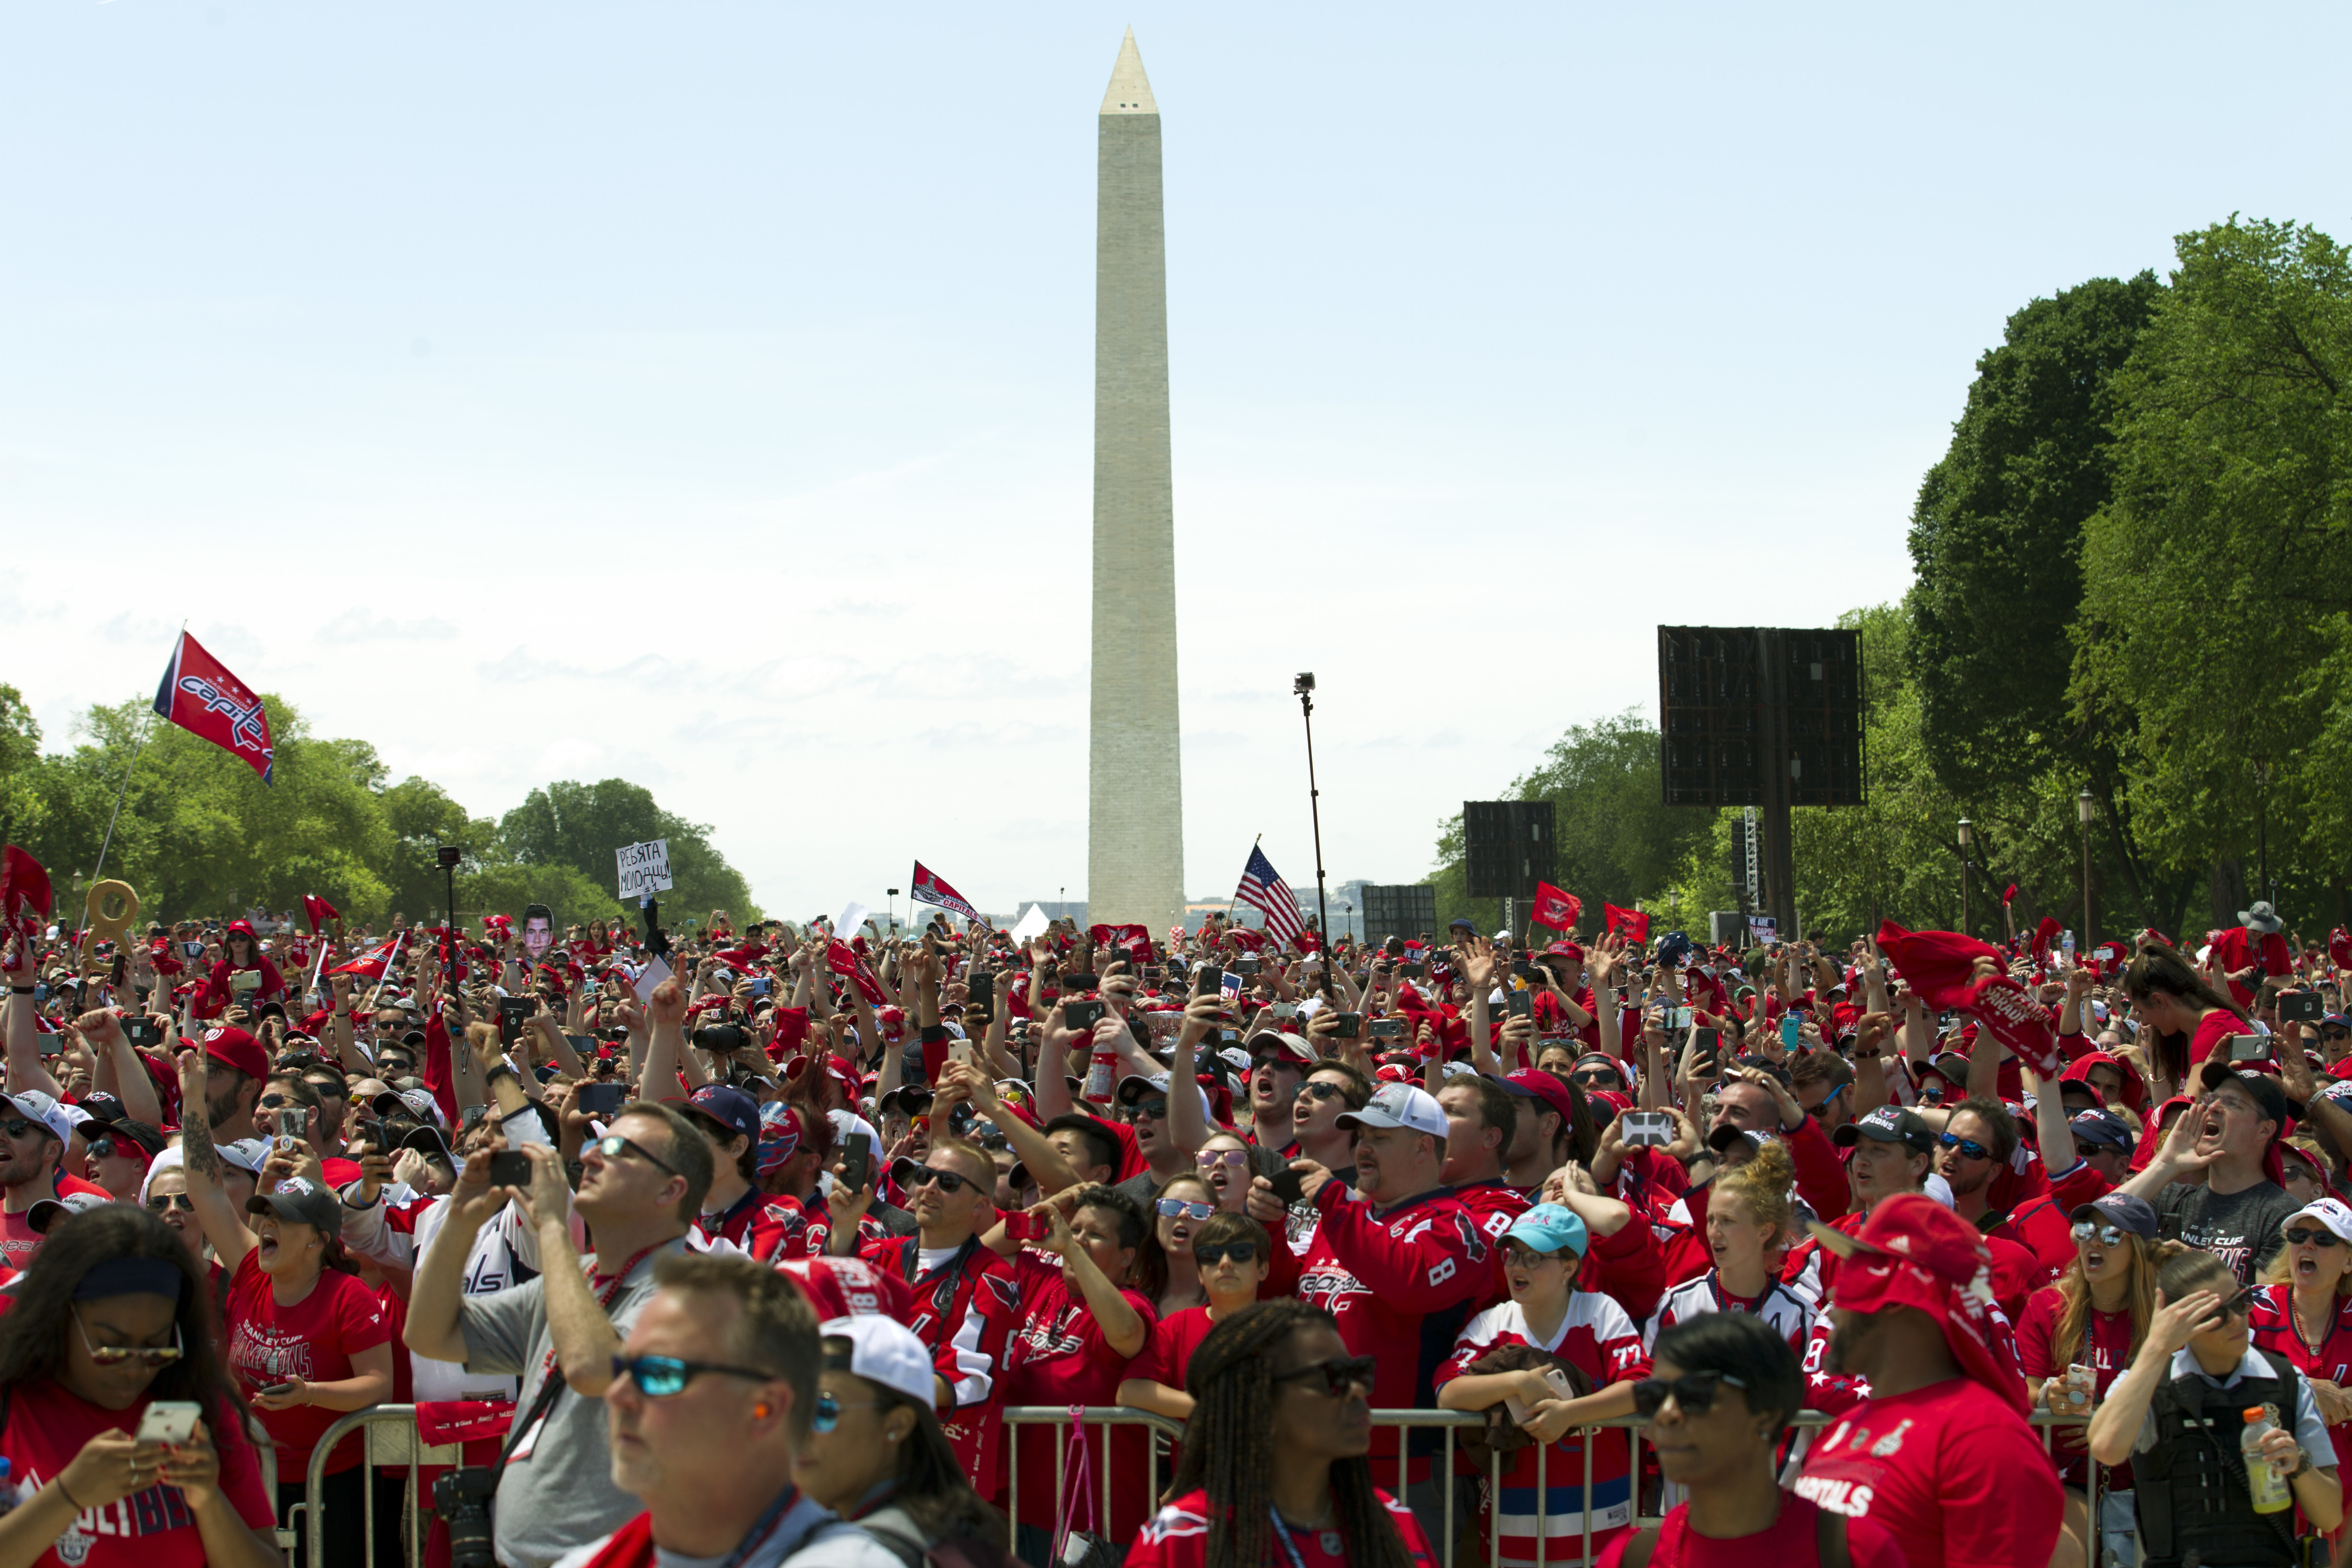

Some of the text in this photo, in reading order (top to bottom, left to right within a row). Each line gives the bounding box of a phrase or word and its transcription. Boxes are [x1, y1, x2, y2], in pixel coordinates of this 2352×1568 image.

[206, 677, 250, 711] WASHINGTON
[179, 675, 263, 752] capita
[620, 843, 661, 868] РЕБЯТА
[621, 860, 671, 892] МОЛОДЦЫ!
[915, 884, 944, 900] CHAMPIONS
[945, 894, 969, 907] WASHINGTON
[943, 899, 978, 919] CAPITALS
[1758, 919, 1768, 927] ARE
[1859, 1113, 1895, 1131] PIONS
[1483, 1210, 1512, 1238] 8
[0, 1240, 44, 1252] ear
[2181, 1232, 2245, 1246] ANLEY CUP
[1428, 1257, 1456, 1287] 8
[243, 1318, 304, 1346] STANLEY CUP
[1613, 1344, 1641, 1371] 77
[1802, 1339, 1826, 1372] 9
